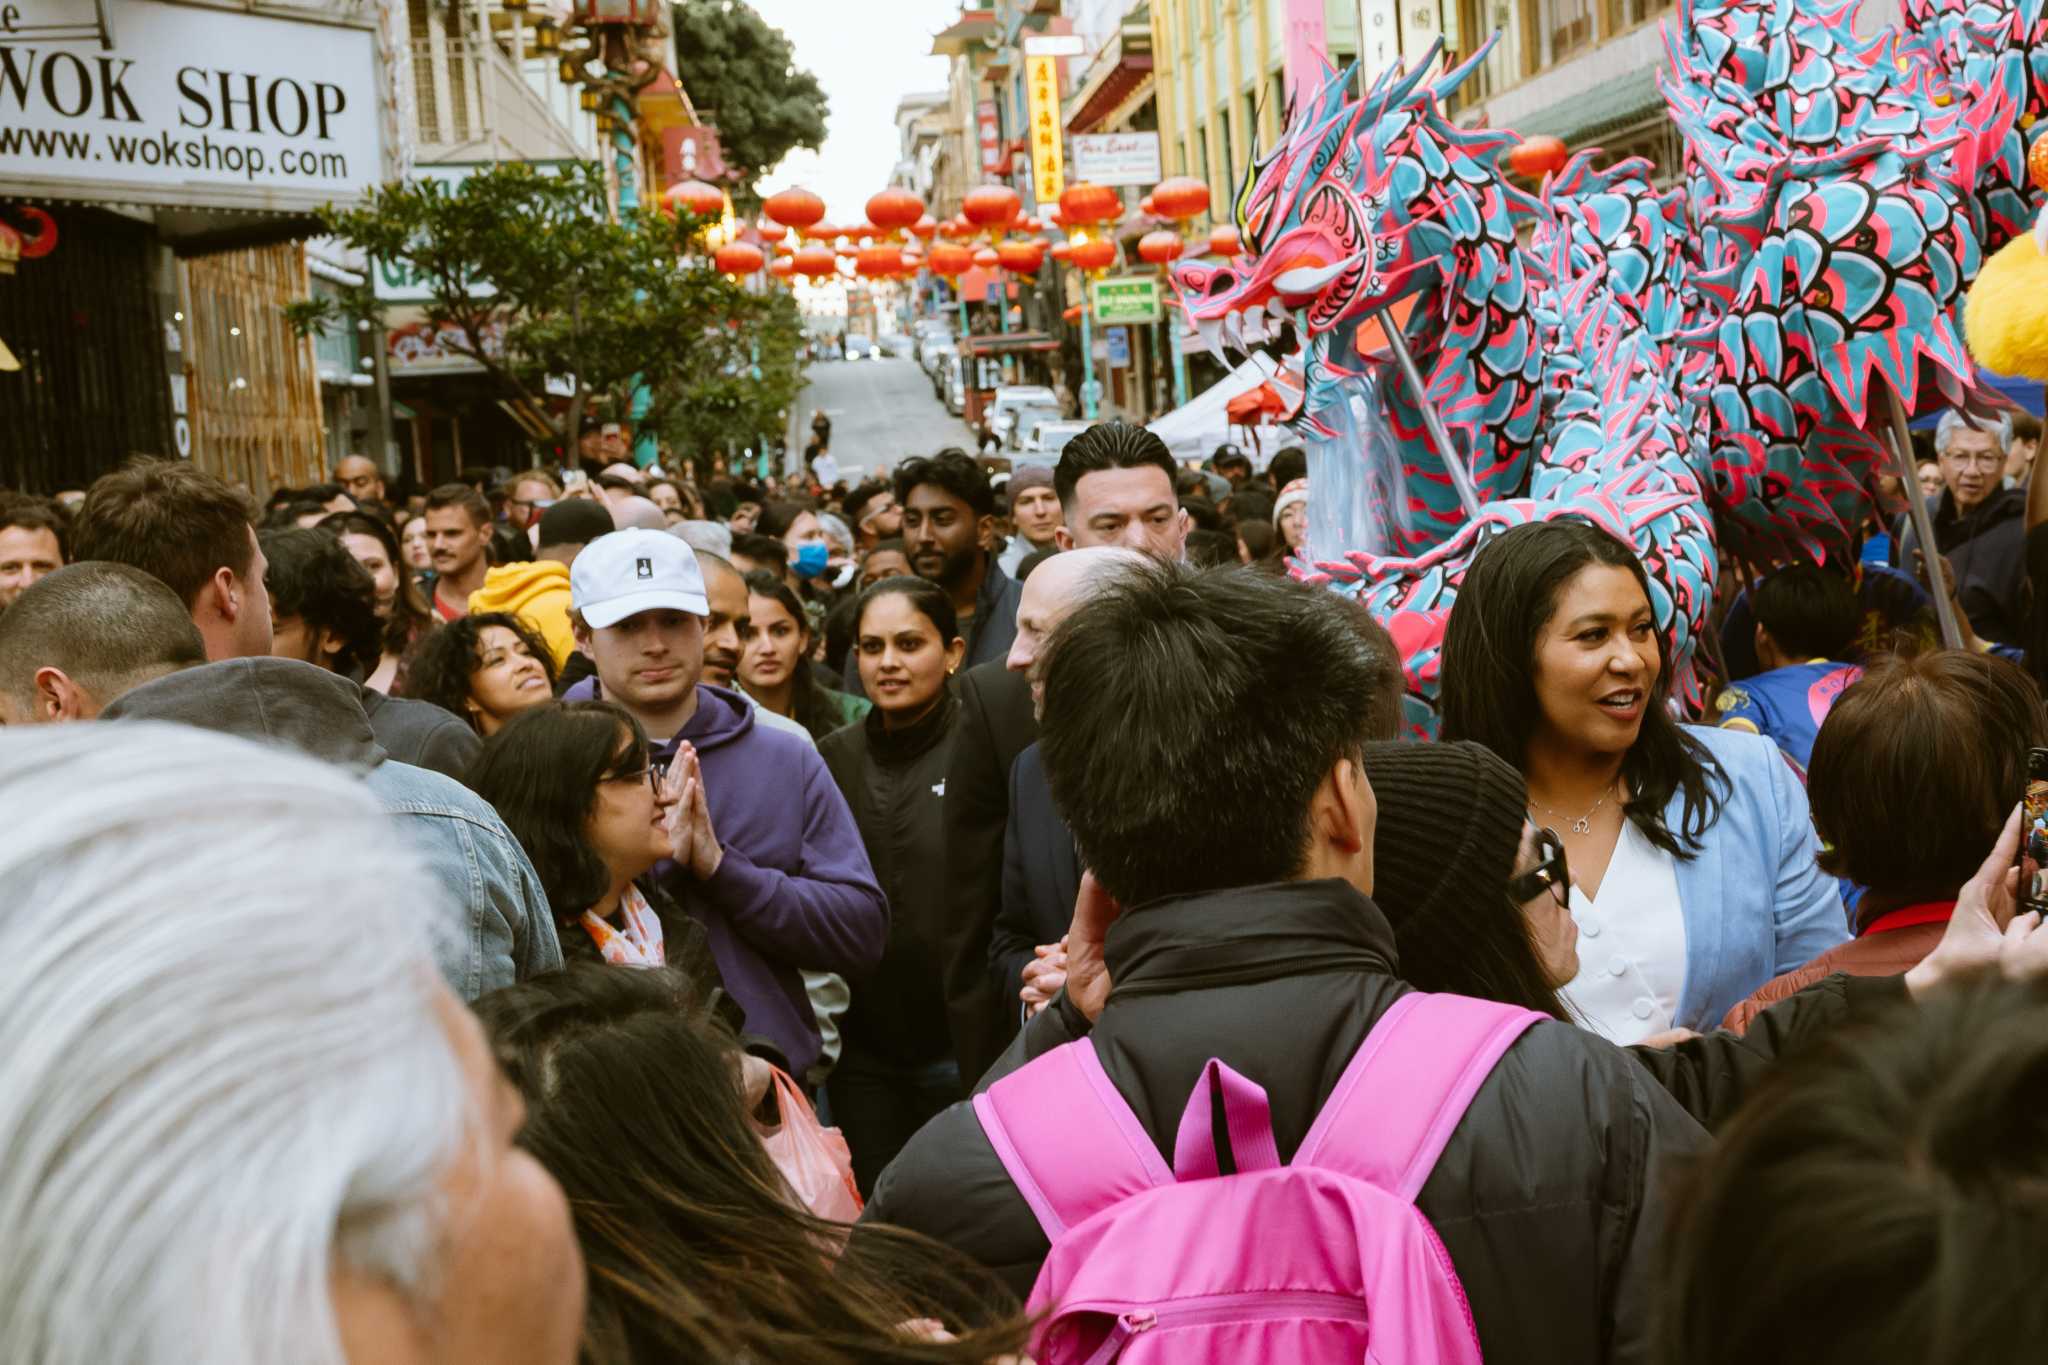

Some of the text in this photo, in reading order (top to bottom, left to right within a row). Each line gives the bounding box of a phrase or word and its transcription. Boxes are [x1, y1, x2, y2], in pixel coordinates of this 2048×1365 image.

[0, 47, 347, 140] WOK SHOP
[0, 126, 348, 181] www.wokshop.com
